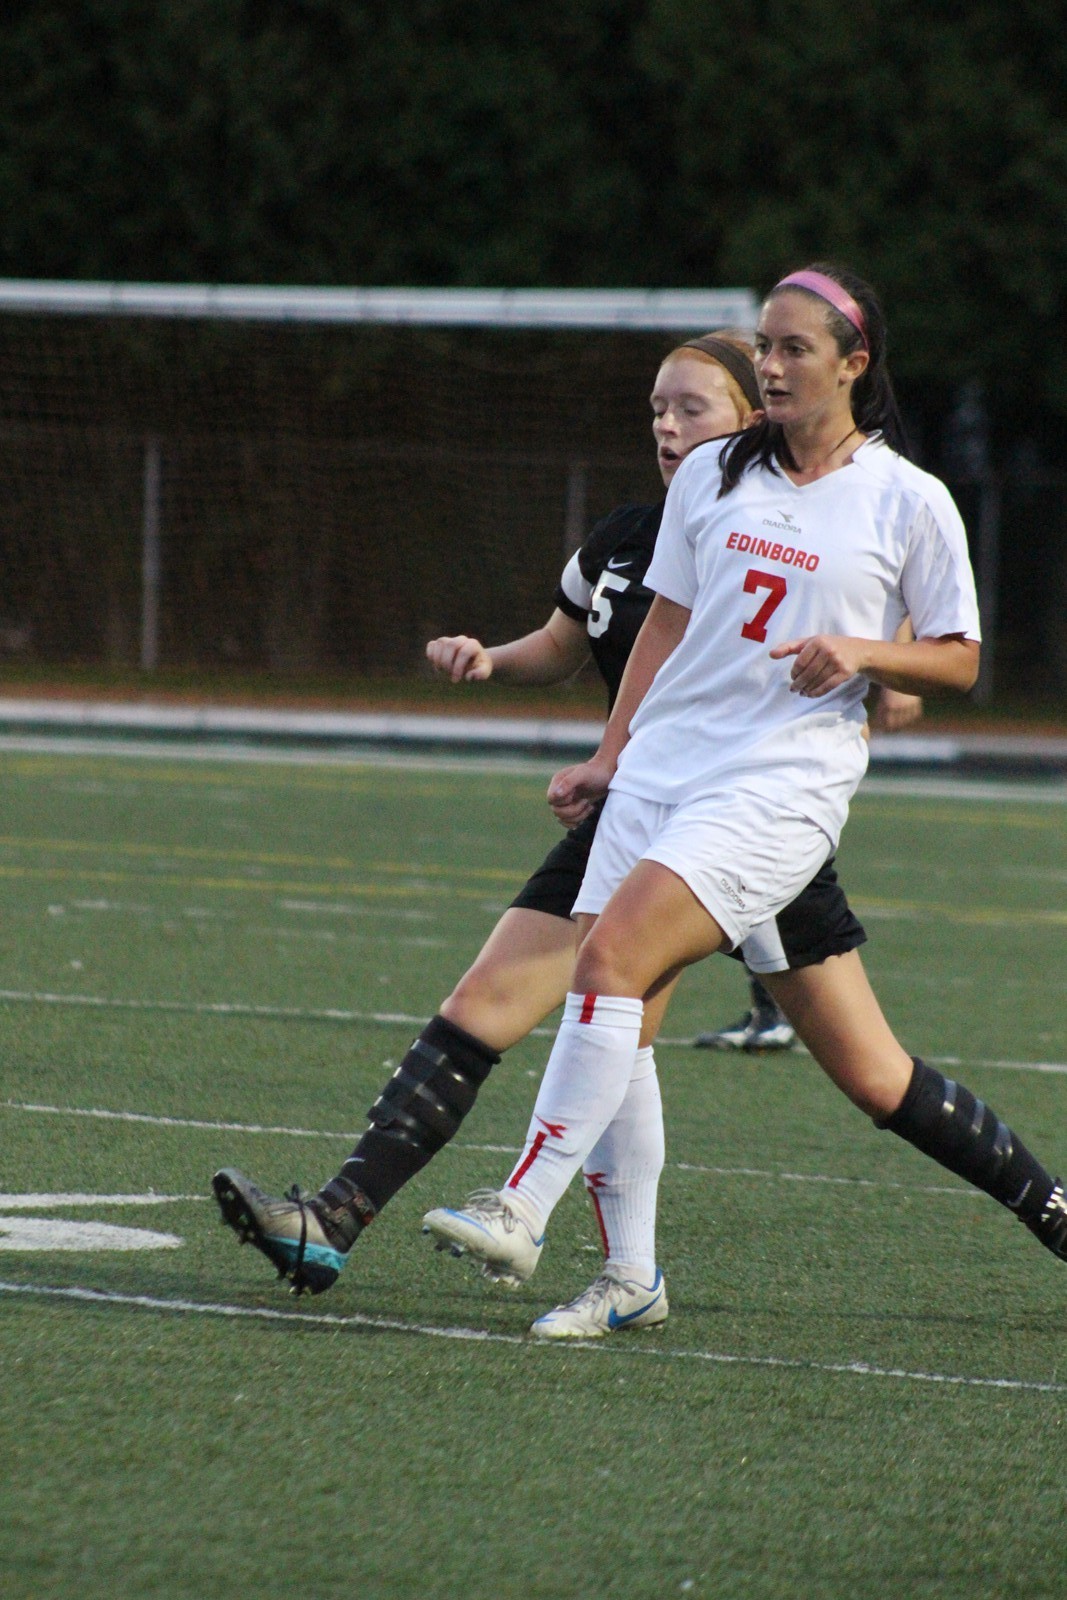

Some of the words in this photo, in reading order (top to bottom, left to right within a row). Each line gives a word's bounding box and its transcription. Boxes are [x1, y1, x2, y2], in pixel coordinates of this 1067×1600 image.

[726, 532, 820, 572] EDINBORO
[762, 519, 802, 534] DIADORA
[587, 570, 631, 638] 5
[741, 569, 787, 643] 7
